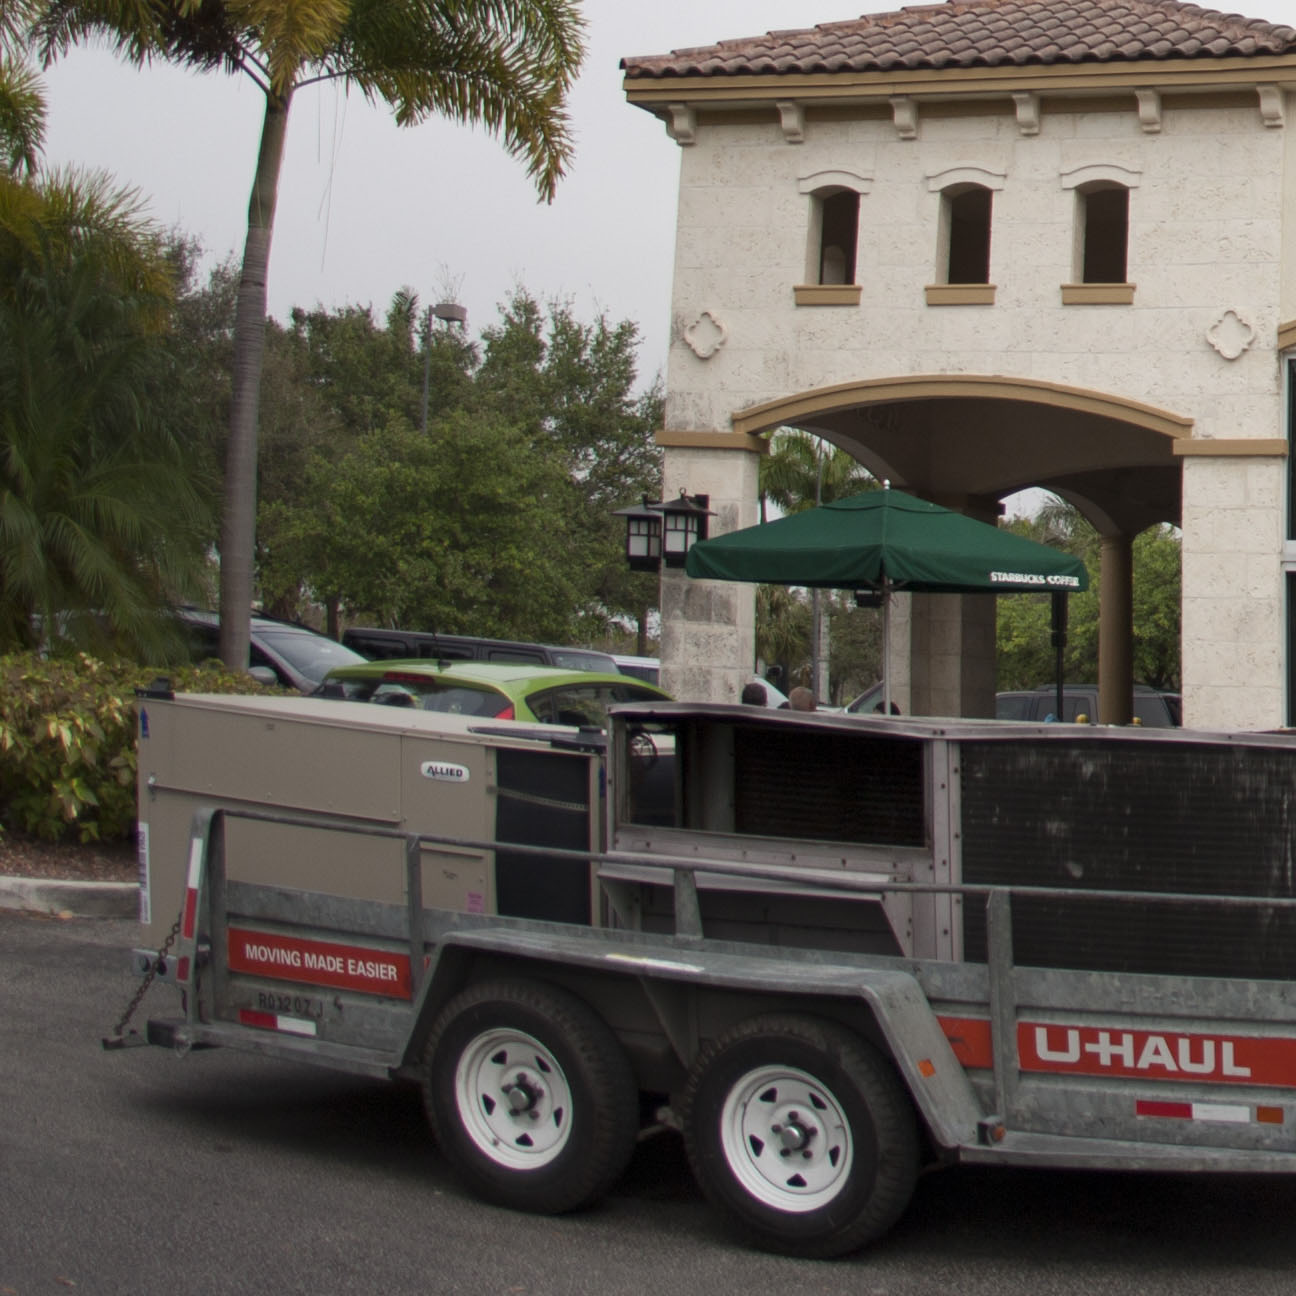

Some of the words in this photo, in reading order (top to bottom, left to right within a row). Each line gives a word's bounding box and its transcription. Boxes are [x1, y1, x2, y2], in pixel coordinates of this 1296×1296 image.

[991, 572, 1046, 584] STARBUCKS
[427, 765, 463, 777] ALLIED
[245, 943, 301, 968] MOVING
[304, 952, 344, 974] MADE
[348, 959, 398, 982] EASIER
[1035, 1026, 1251, 1077] U-HAUL
